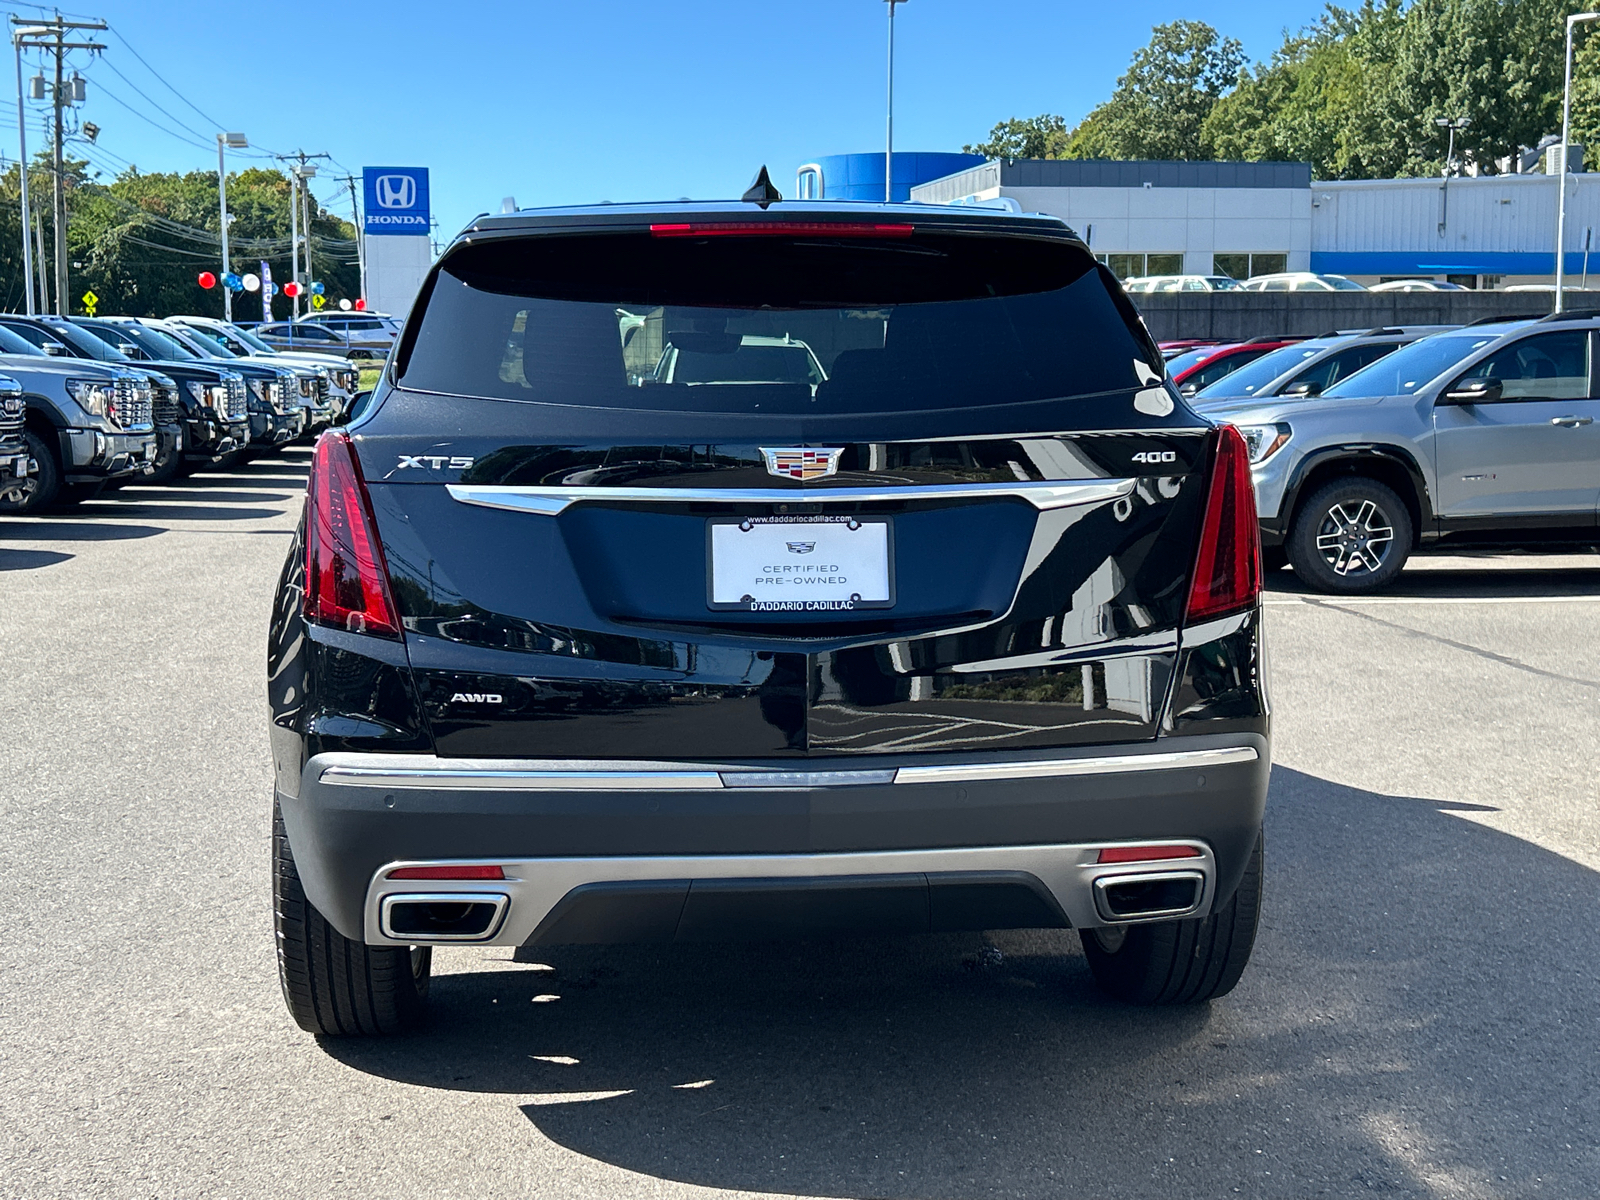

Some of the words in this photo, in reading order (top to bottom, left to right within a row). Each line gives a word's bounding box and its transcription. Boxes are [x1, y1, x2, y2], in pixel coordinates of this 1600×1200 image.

[366, 215, 427, 225] HONDA
[397, 455, 475, 469] XT5
[1131, 451, 1177, 464] 400
[747, 514, 853, 524] www.daddariocadillac.com
[762, 564, 840, 574] CERTIFIED
[755, 576, 848, 586] PRE-OWNED
[750, 601, 804, 612] D'ADDARIO
[805, 600, 855, 611] CADILLAC
[450, 692, 504, 704] AWD
